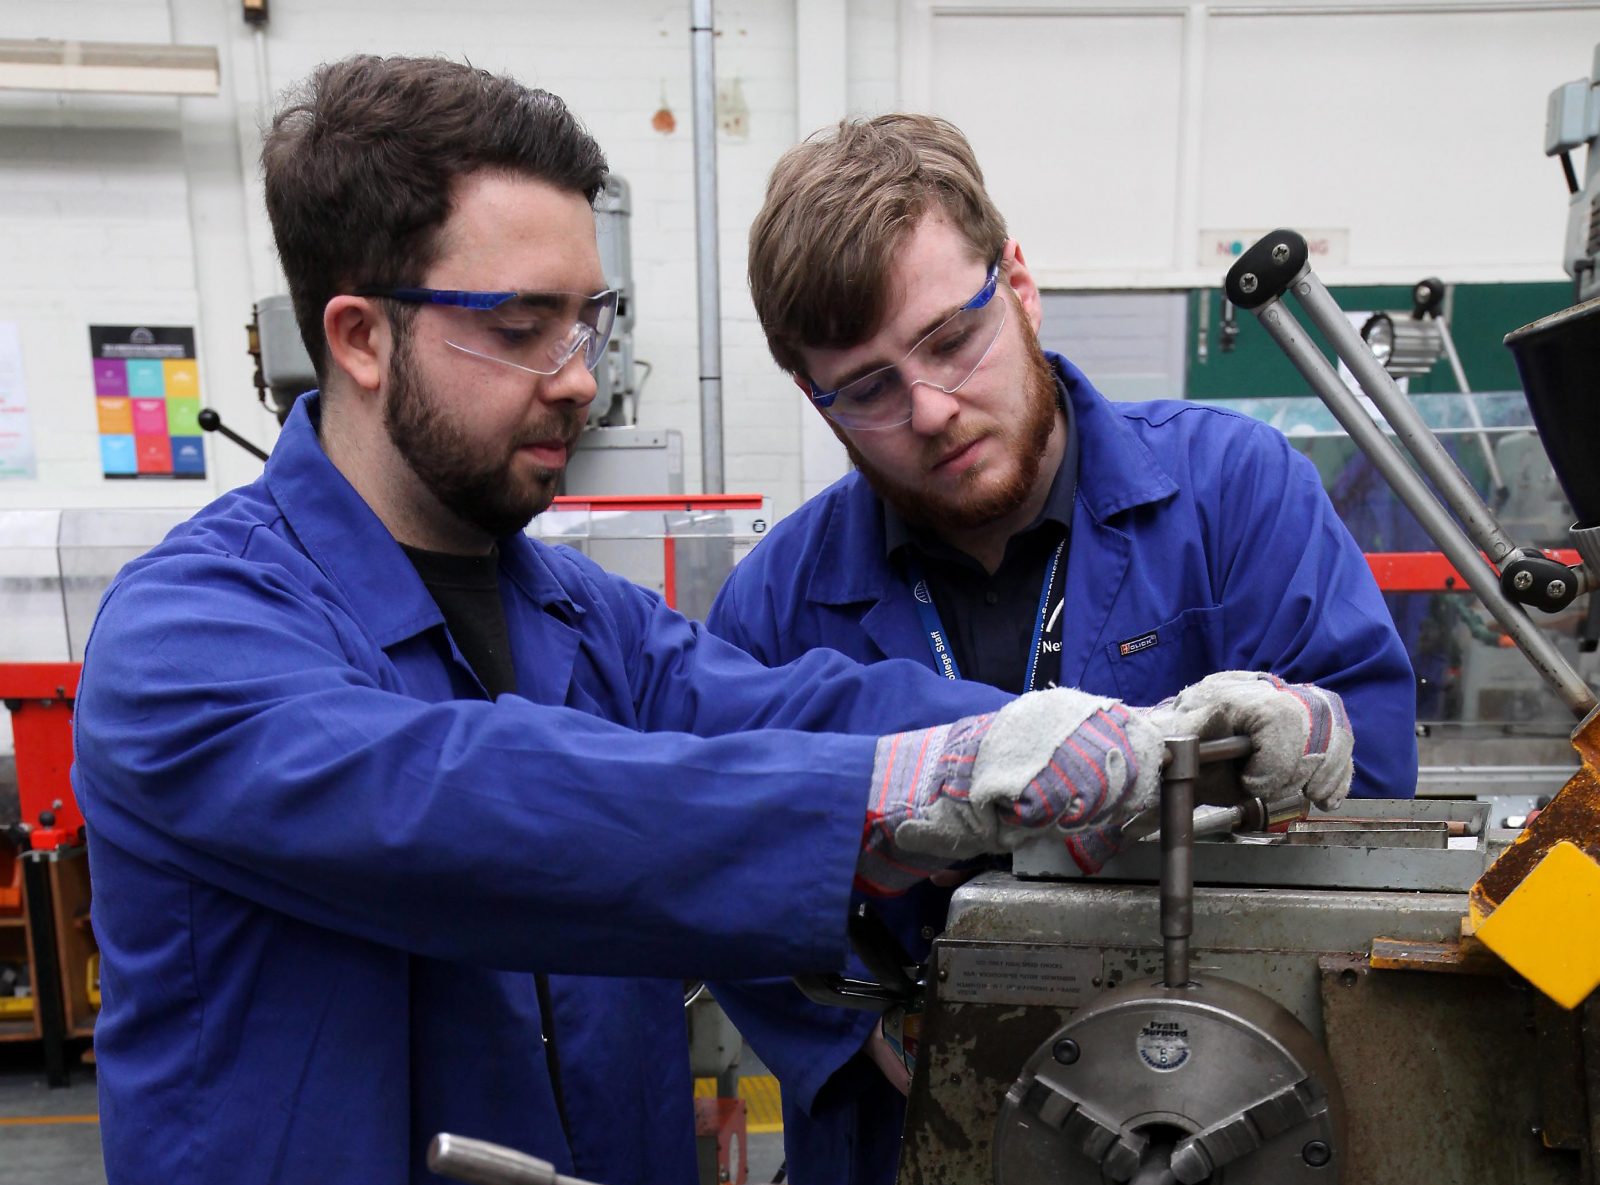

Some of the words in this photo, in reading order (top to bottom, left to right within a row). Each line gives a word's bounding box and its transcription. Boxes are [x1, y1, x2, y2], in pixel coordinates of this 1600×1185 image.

[930, 631, 945, 653] Staff
[1042, 640, 1063, 654] Ne
[941, 653, 956, 680] ollege
